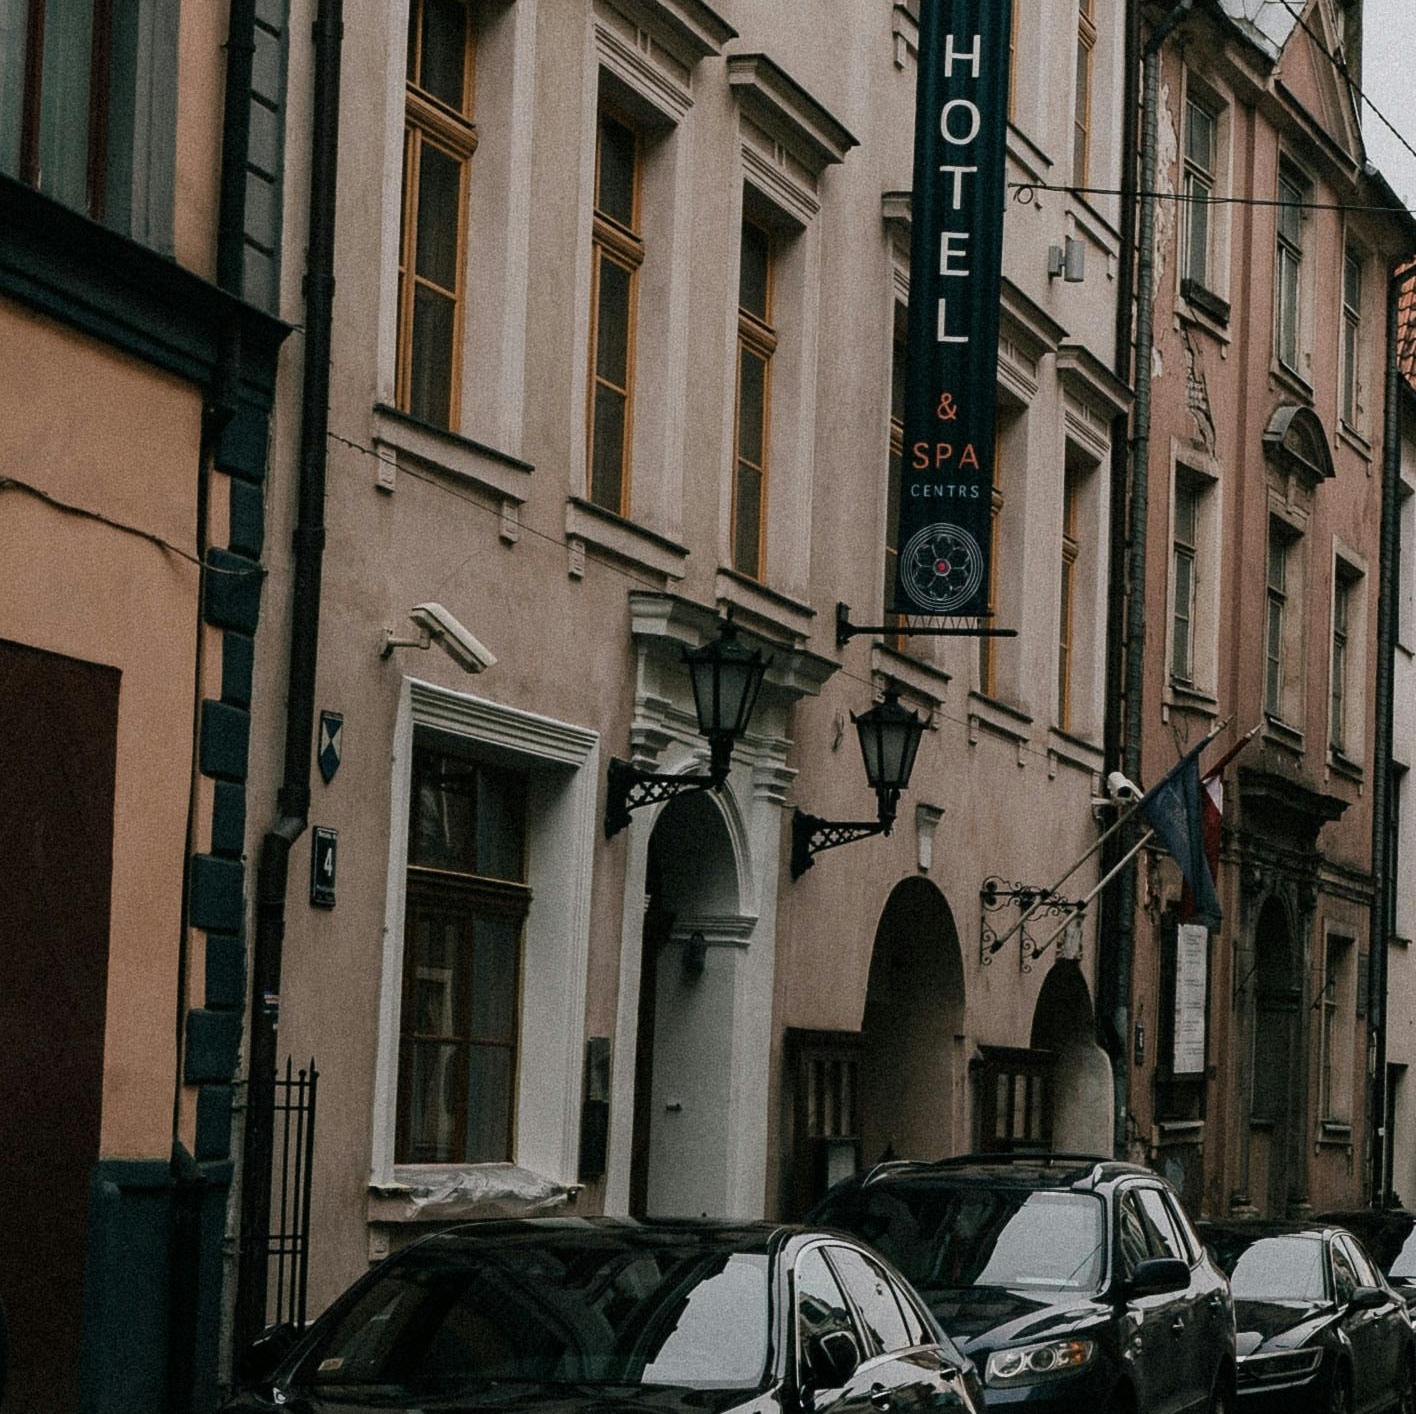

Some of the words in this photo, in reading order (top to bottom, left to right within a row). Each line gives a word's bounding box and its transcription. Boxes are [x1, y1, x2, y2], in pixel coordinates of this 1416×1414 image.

[937, 34, 980, 343] HOTEL
[936, 393, 957, 420] &
[912, 442, 979, 470] SPA
[911, 483, 979, 498] CENTRS
[324, 847, 332, 876] 4
